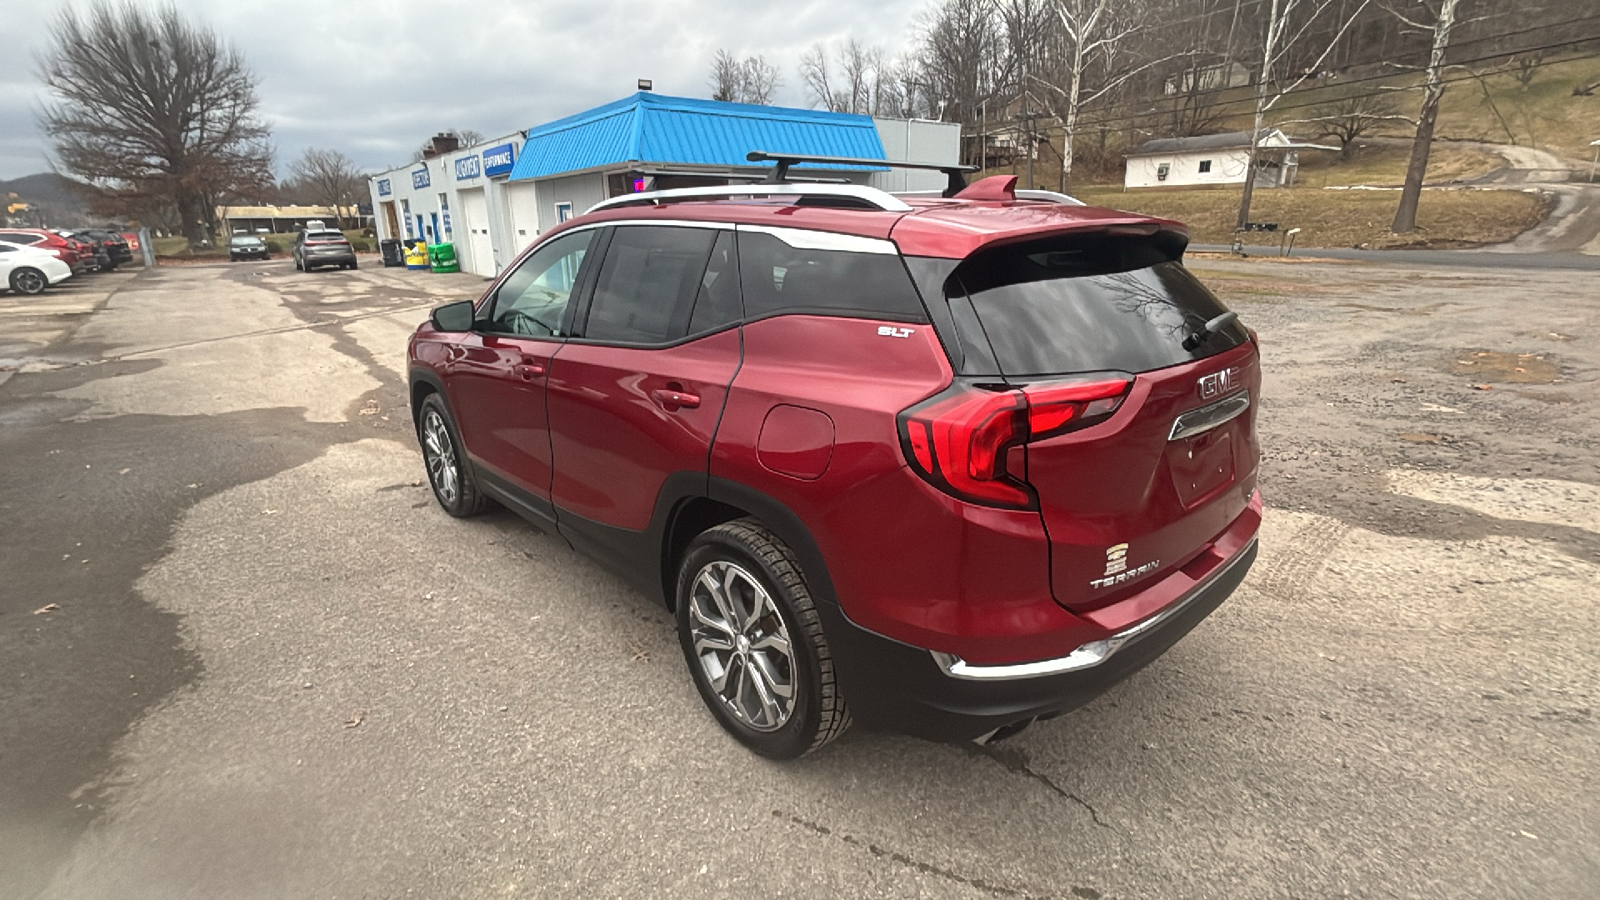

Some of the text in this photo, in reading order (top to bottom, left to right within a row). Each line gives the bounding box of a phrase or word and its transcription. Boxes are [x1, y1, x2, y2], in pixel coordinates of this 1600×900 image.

[877, 325, 916, 339] SLT
[1197, 366, 1240, 400] GMC
[1089, 559, 1160, 589] TERRAIN
